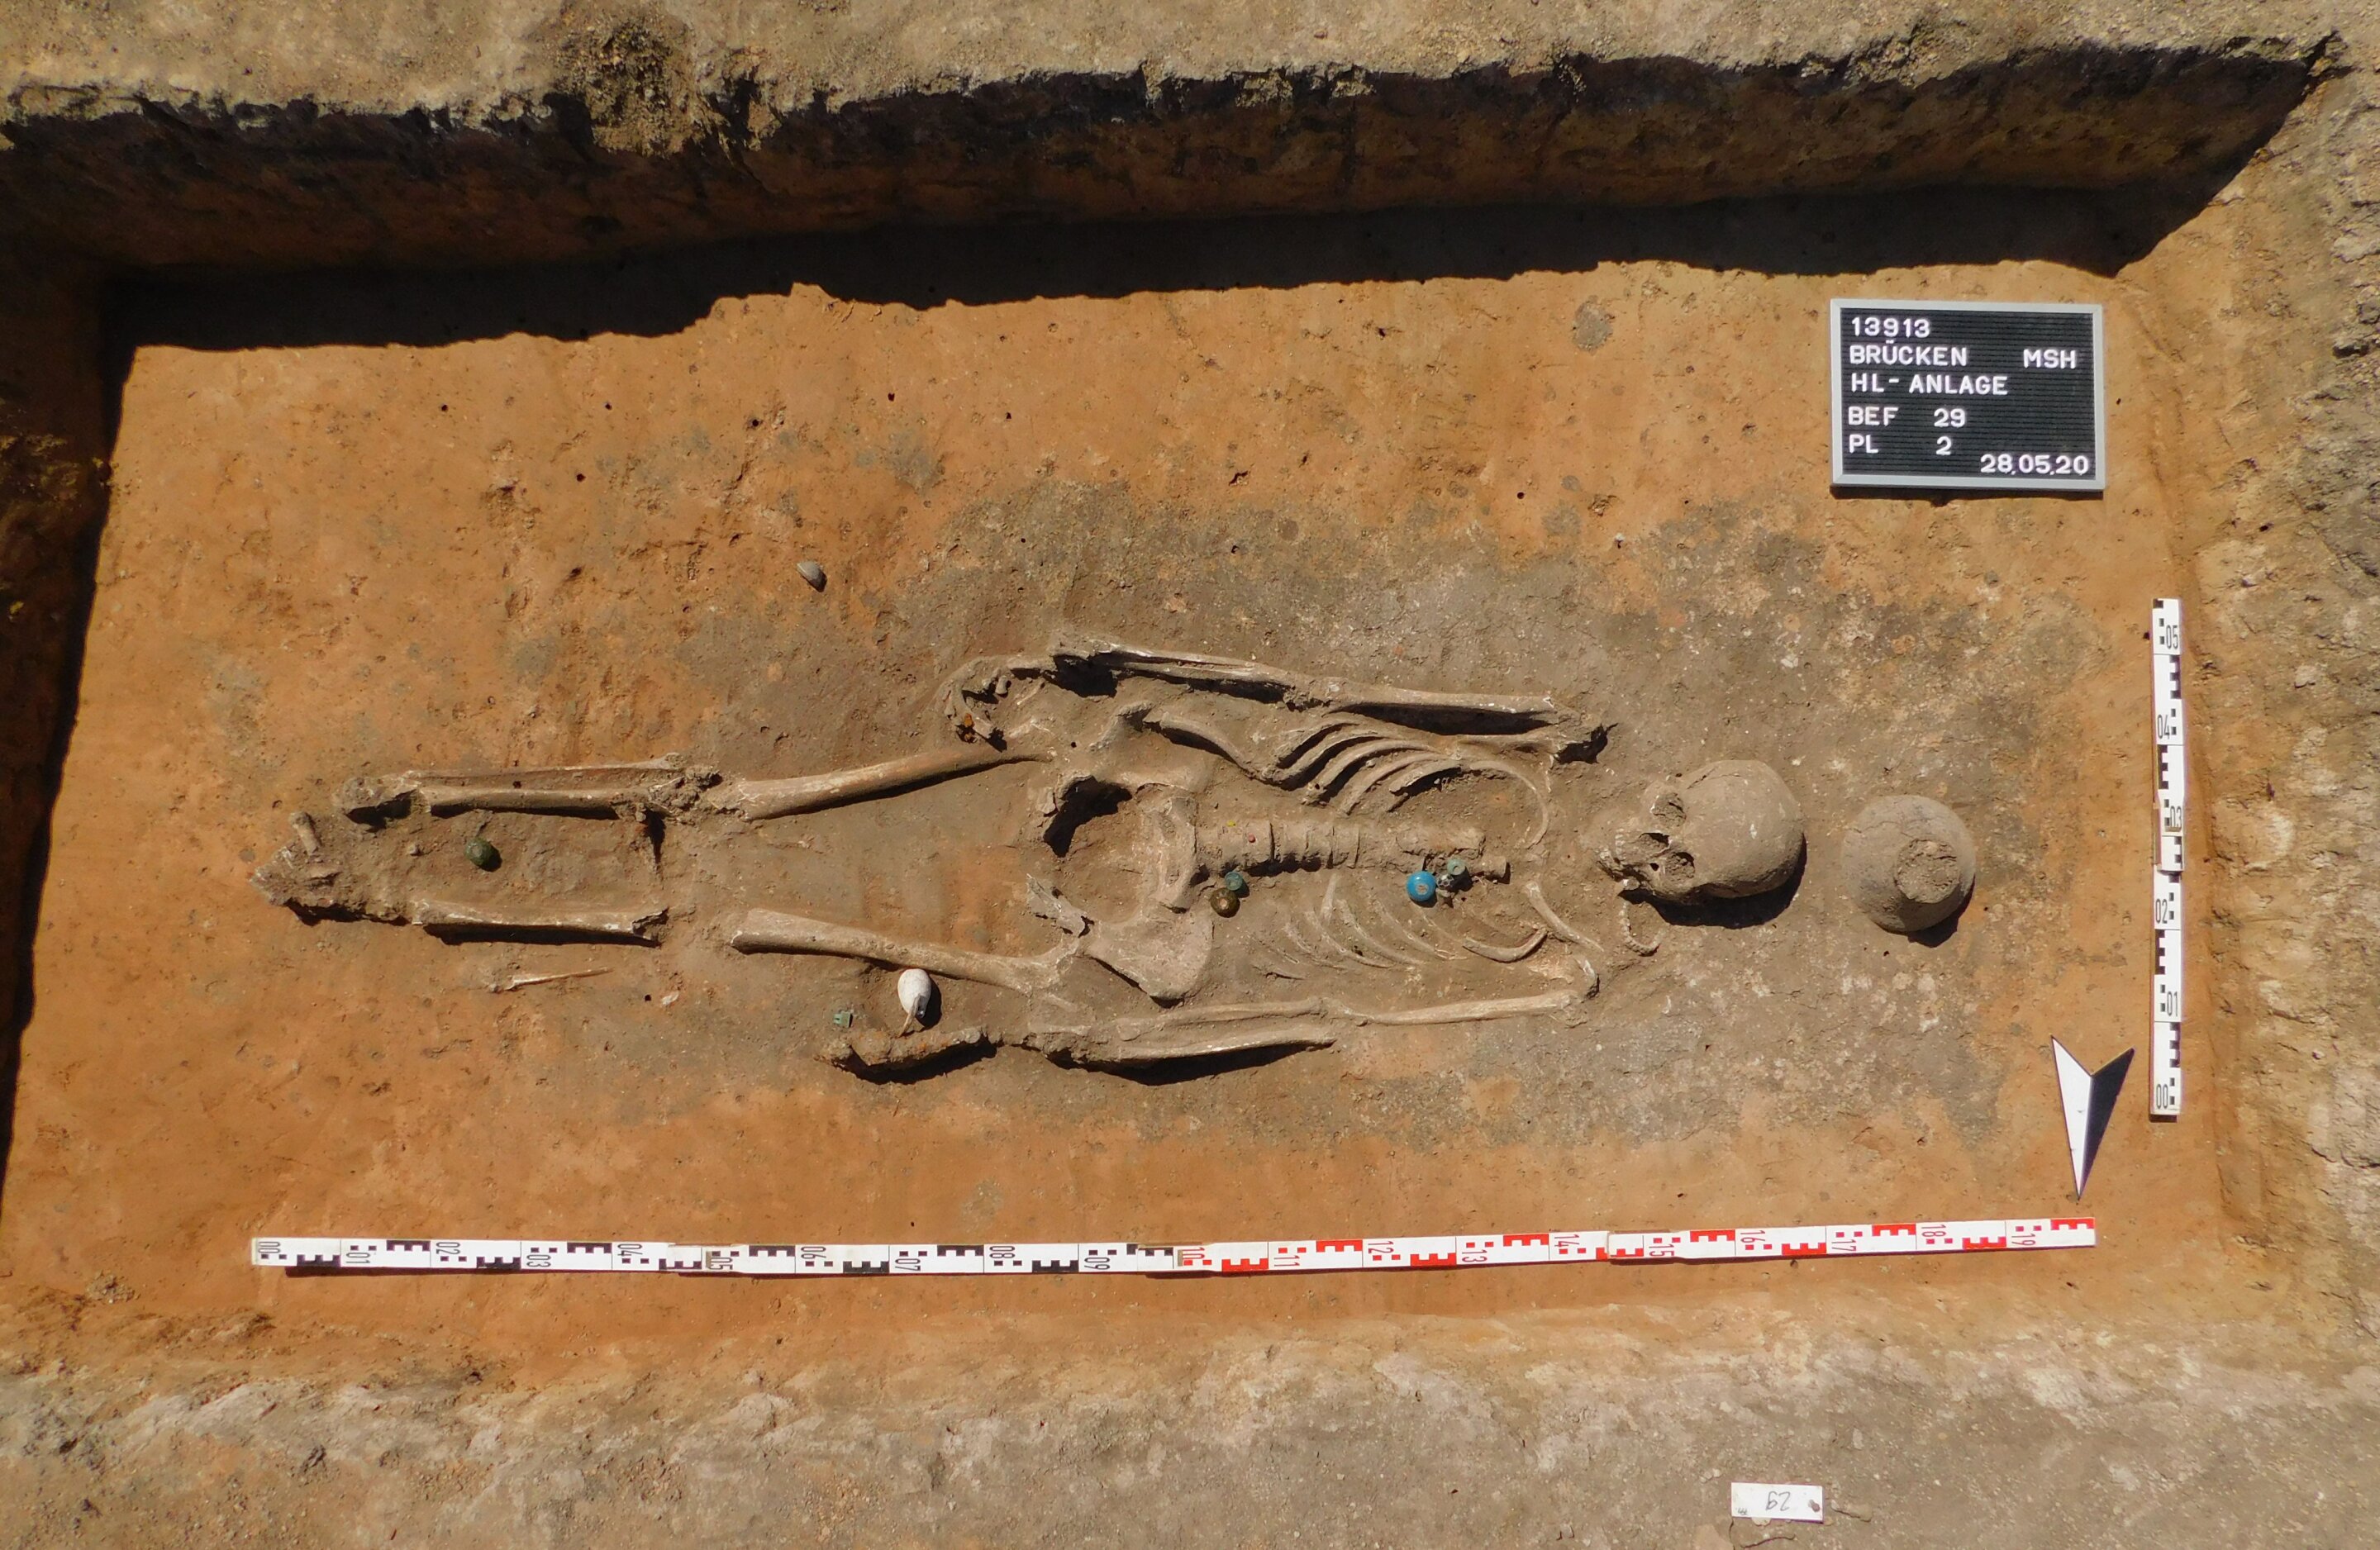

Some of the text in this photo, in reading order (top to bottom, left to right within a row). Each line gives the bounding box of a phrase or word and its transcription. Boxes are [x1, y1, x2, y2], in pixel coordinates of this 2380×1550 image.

[1851, 316, 1930, 338] 13913
[1849, 340, 2077, 369] BRÜCKEN MSH
[1848, 406, 1966, 428] BEF 29
[1849, 434, 1952, 455] PL 2
[1980, 454, 2089, 476] 28.05.20
[2166, 625, 2178, 649] 05
[2157, 715, 2170, 739] 04
[2170, 806, 2182, 829] 03
[2155, 898, 2168, 924] 02
[2167, 991, 2178, 1017] 01
[2156, 1084, 2168, 1110] 00
[1740, 1229, 1766, 1243] 16
[1921, 1224, 1947, 1238] 18
[1554, 1234, 1580, 1248] 14
[1831, 1239, 1857, 1253] 17
[2011, 1233, 2036, 1246] 19
[258, 1241, 280, 1253] 00
[436, 1242, 460, 1255] 02
[617, 1243, 643, 1257] 04
[801, 1246, 826, 1259] 06
[989, 1245, 1016, 1258] 08
[1368, 1240, 1394, 1254] 12
[1649, 1243, 1675, 1257] 15
[345, 1252, 370, 1264] 01
[526, 1254, 551, 1267] 03
[1273, 1254, 1300, 1267] 11
[1461, 1249, 1488, 1263] 13
[895, 1258, 921, 1272] 07
[1084, 1257, 1111, 1270] 09
